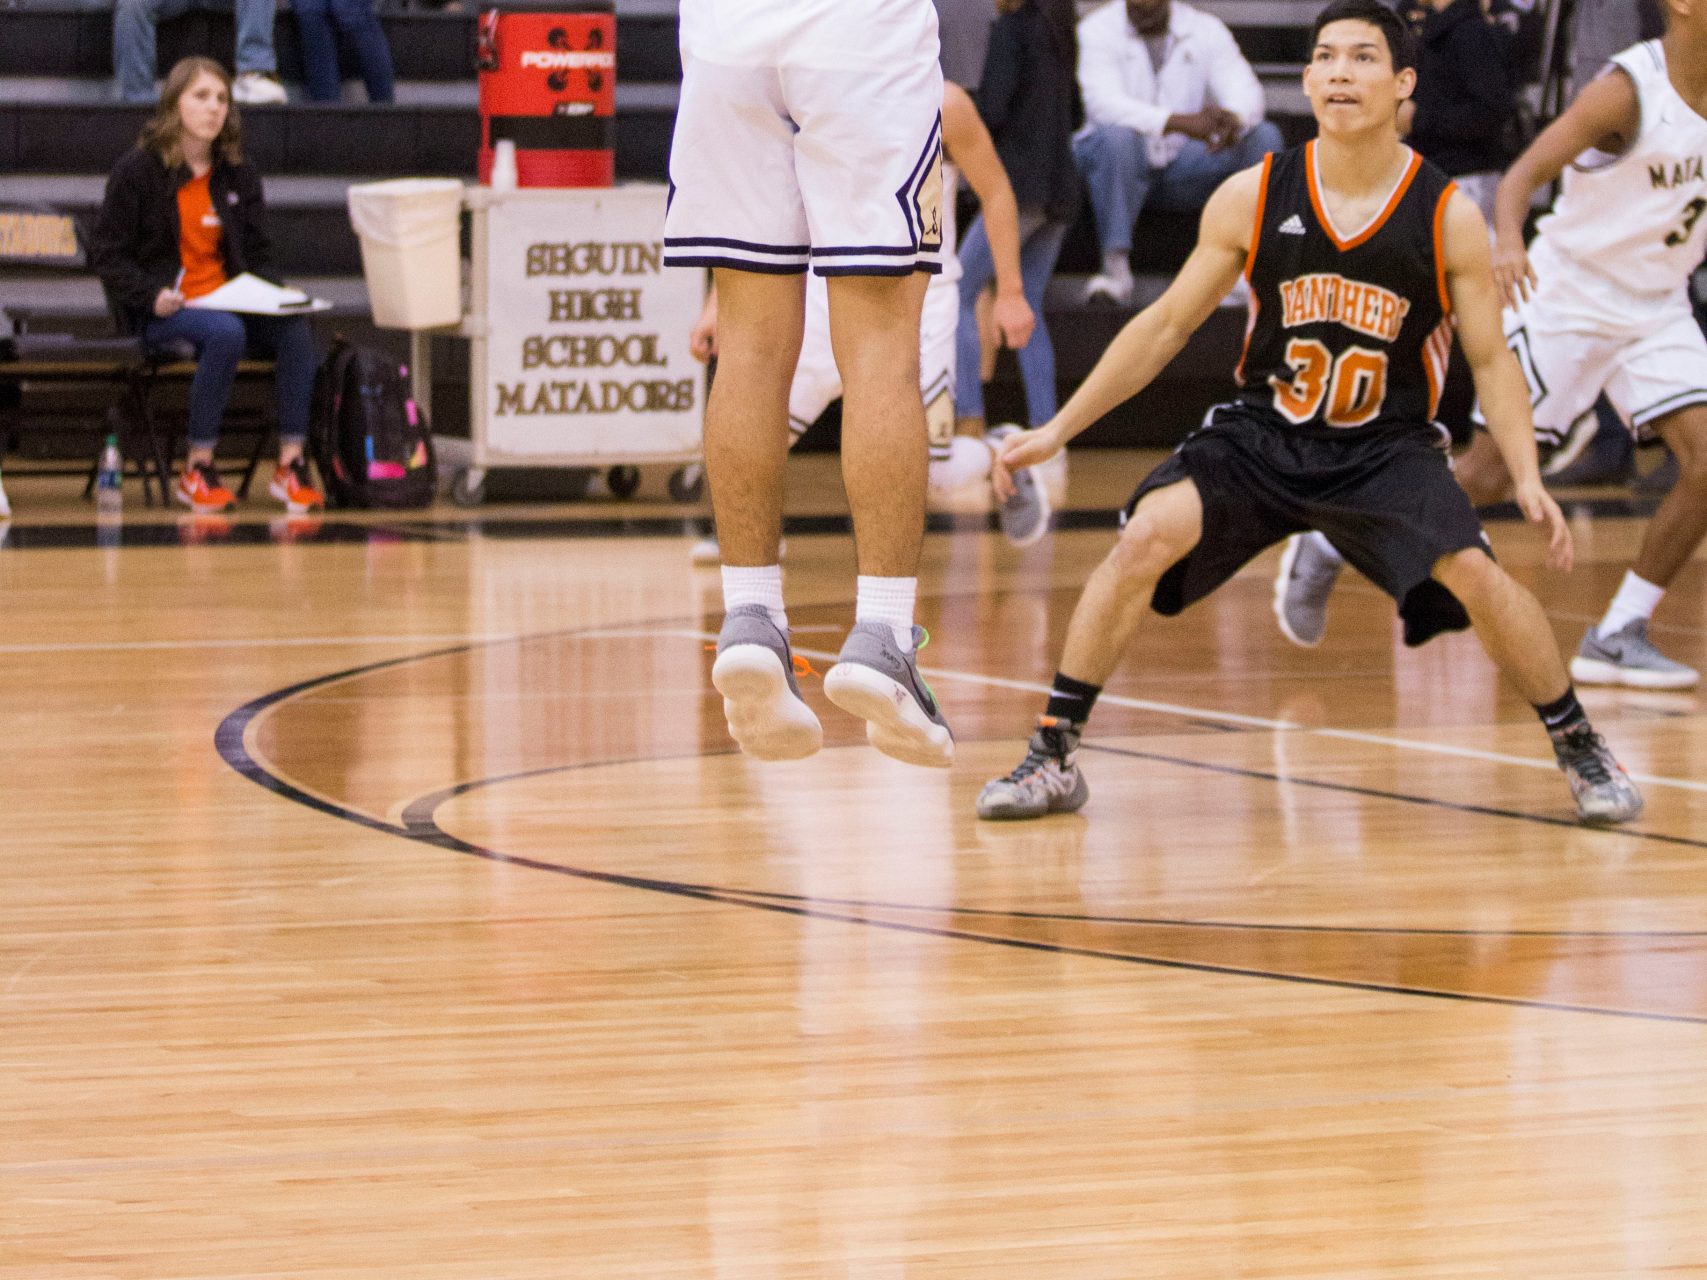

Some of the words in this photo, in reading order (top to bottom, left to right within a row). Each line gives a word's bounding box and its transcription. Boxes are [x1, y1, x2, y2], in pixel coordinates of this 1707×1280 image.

[525, 240, 663, 279] SEGUIN
[546, 286, 643, 323] HIGH
[520, 331, 668, 371] SCHOOL
[494, 376, 696, 418] MATADORS
[1267, 337, 1389, 428] 30
